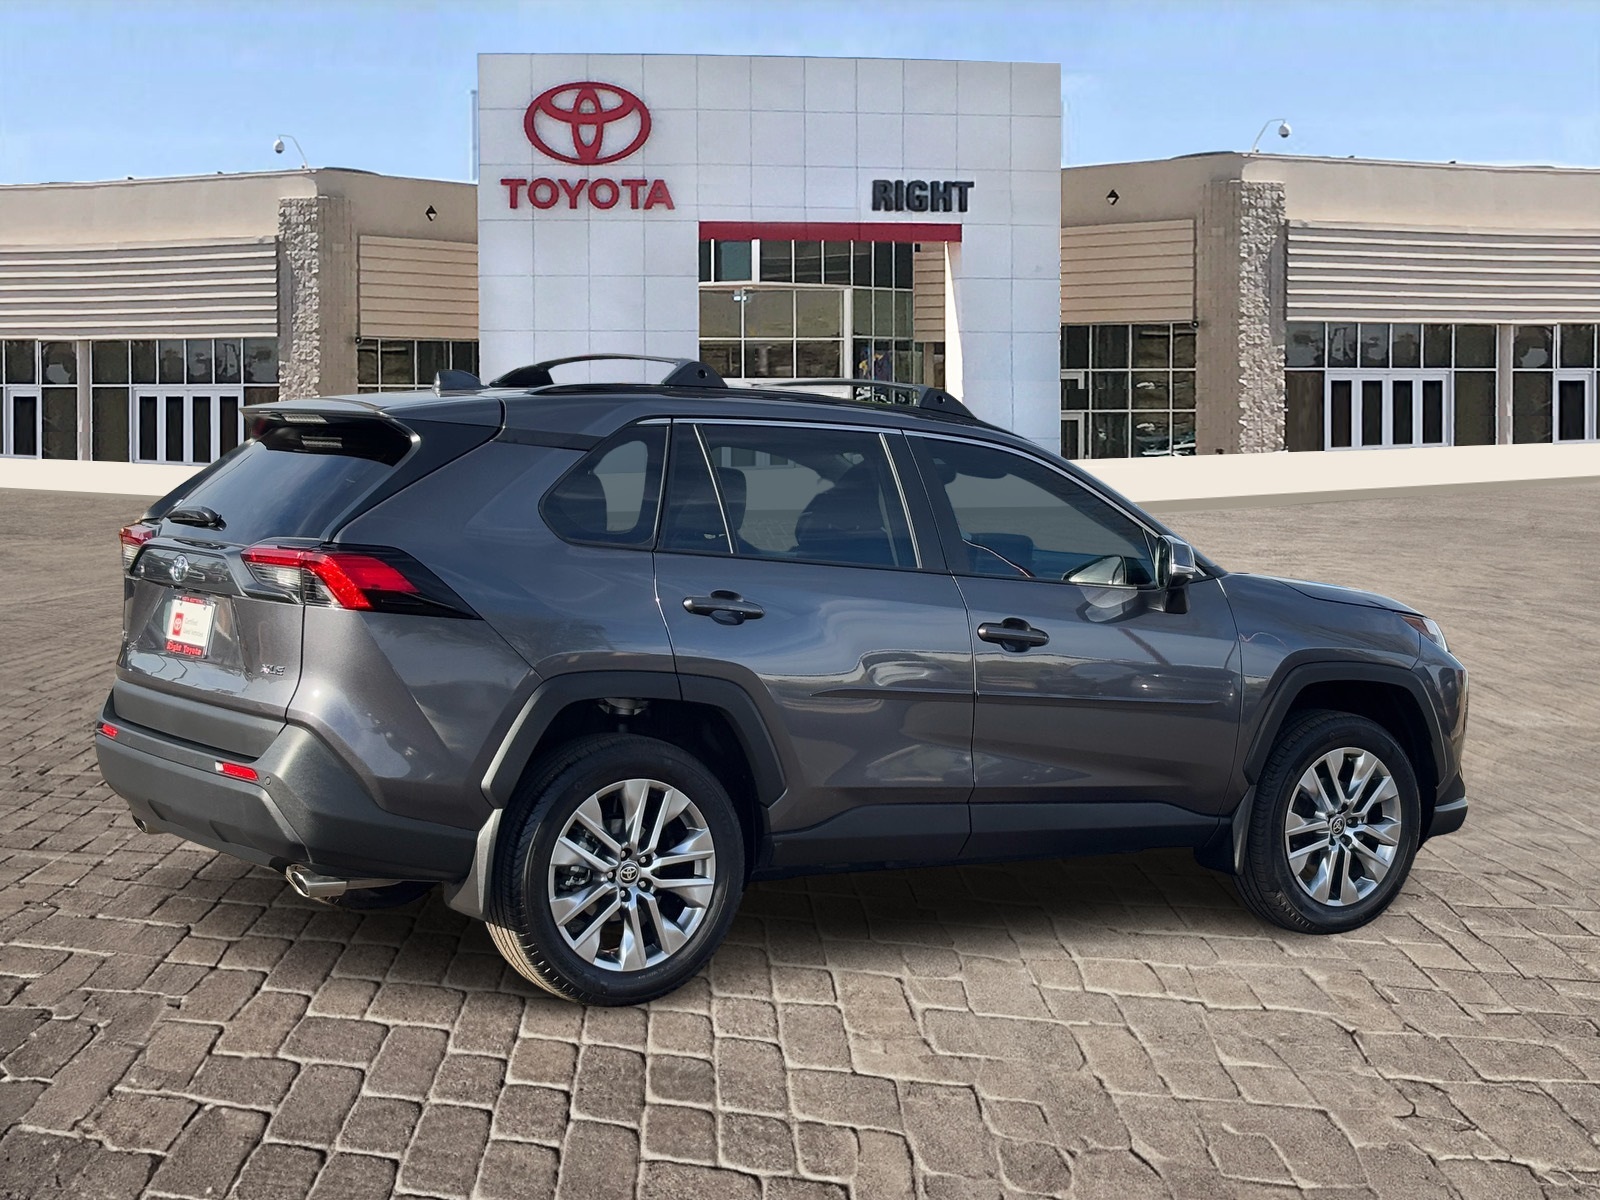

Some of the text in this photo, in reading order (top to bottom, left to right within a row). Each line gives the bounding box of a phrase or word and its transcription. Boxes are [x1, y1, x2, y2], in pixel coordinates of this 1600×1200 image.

[500, 177, 675, 210] TOYOTA
[872, 179, 975, 212] RIGHT
[166, 639, 202, 656] Right Toyota
[260, 663, 285, 676] XLE
